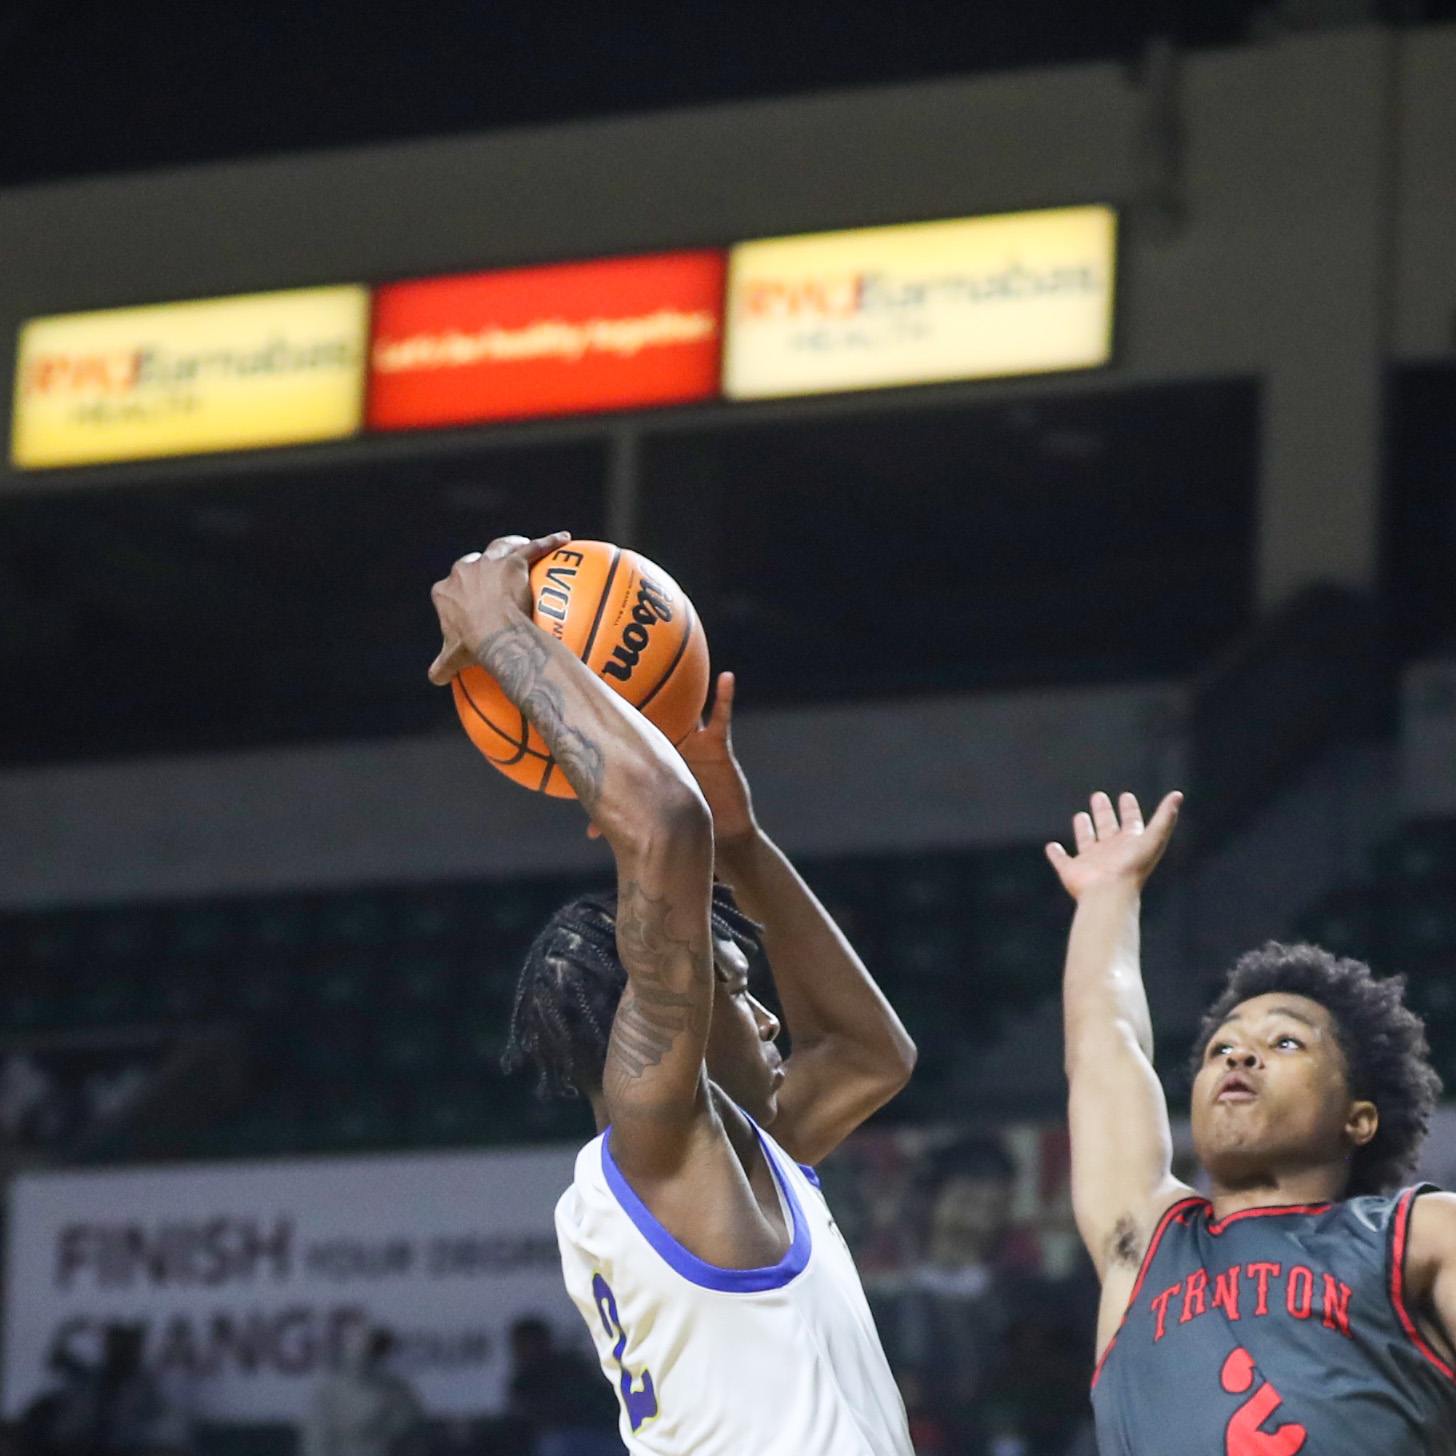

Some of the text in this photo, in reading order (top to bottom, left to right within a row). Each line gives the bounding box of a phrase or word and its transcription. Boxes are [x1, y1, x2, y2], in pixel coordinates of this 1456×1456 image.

[538, 549, 584, 622] EVO
[601, 560, 673, 682] ilson
[54, 1212, 294, 1288] FINISH
[592, 1269, 661, 1436] 2
